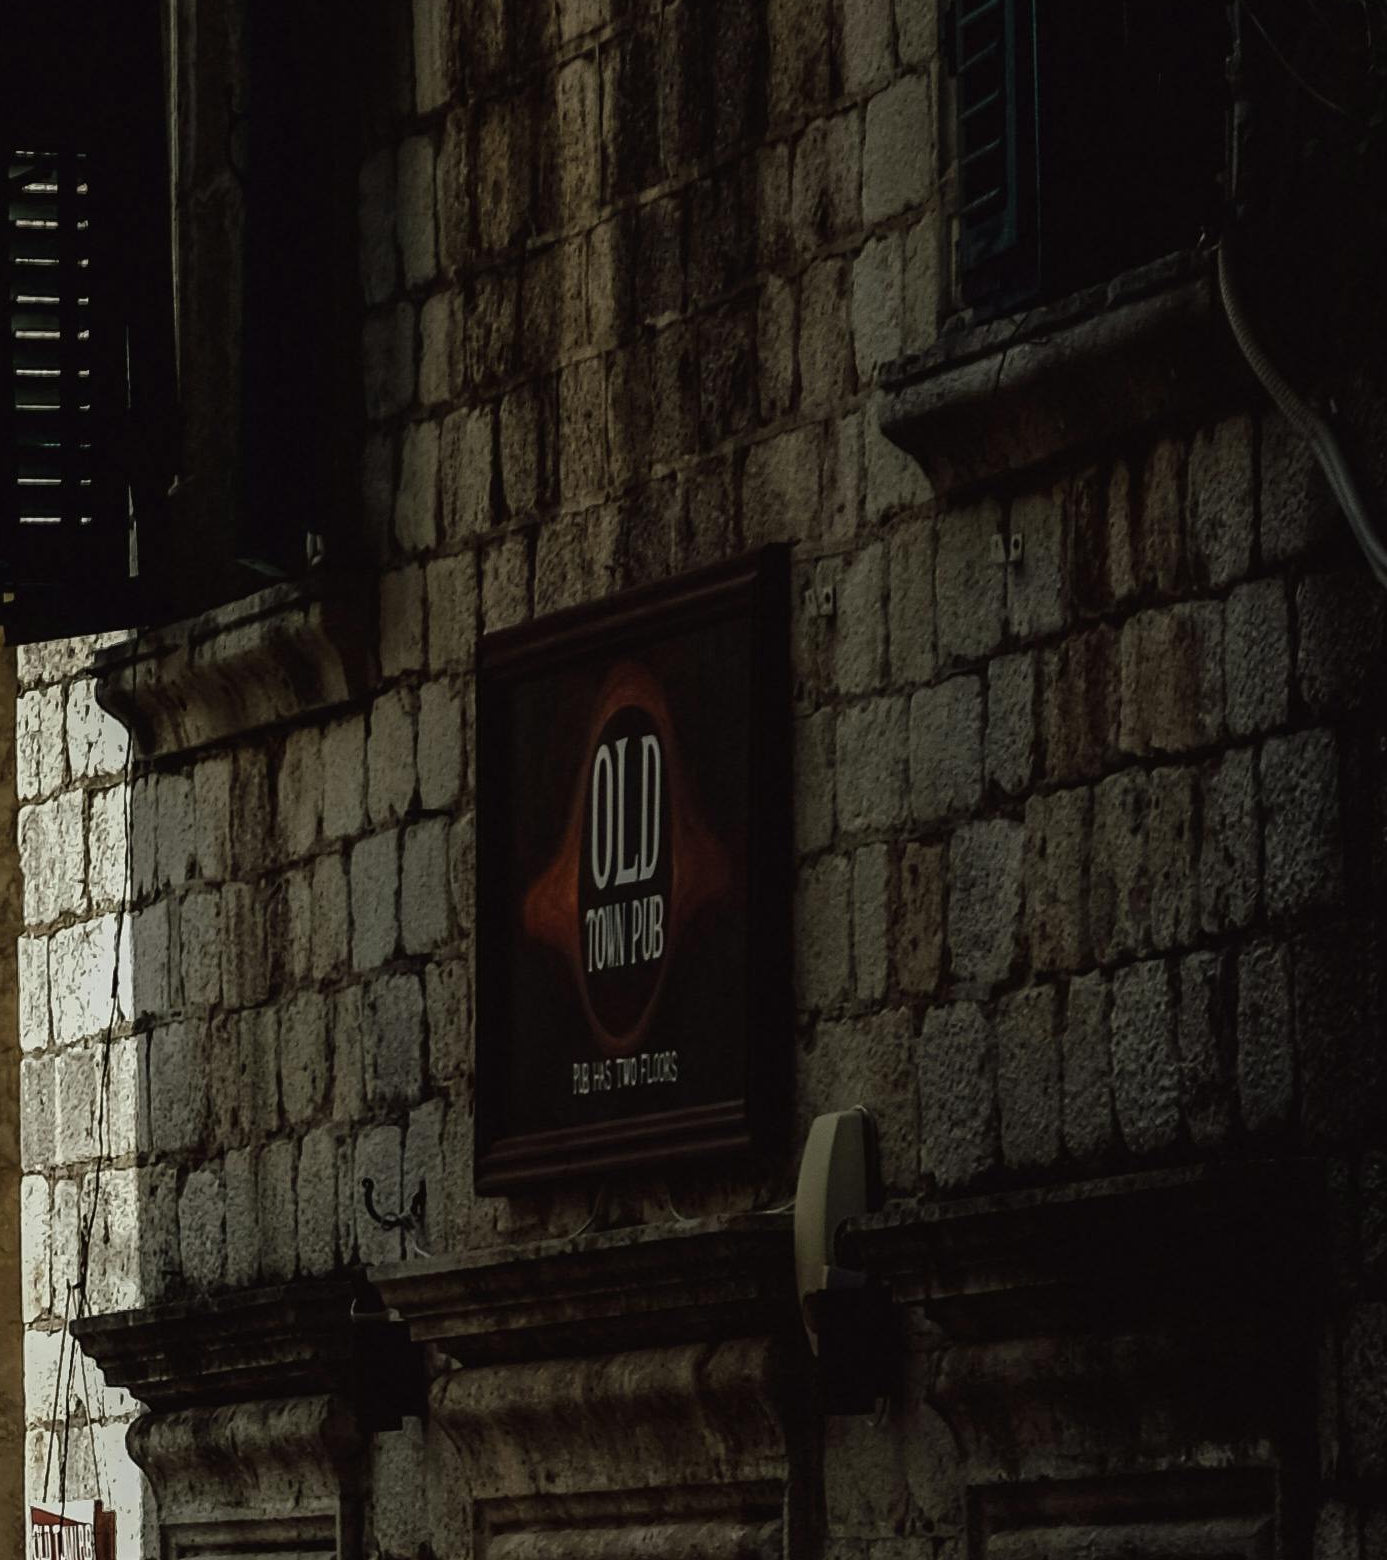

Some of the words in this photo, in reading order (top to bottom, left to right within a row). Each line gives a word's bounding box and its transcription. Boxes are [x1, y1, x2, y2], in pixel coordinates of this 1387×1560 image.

[590, 733, 663, 891] OLD
[585, 901, 627, 974] TOWN
[630, 894, 665, 965] PUB
[615, 1056, 638, 1088] TWO
